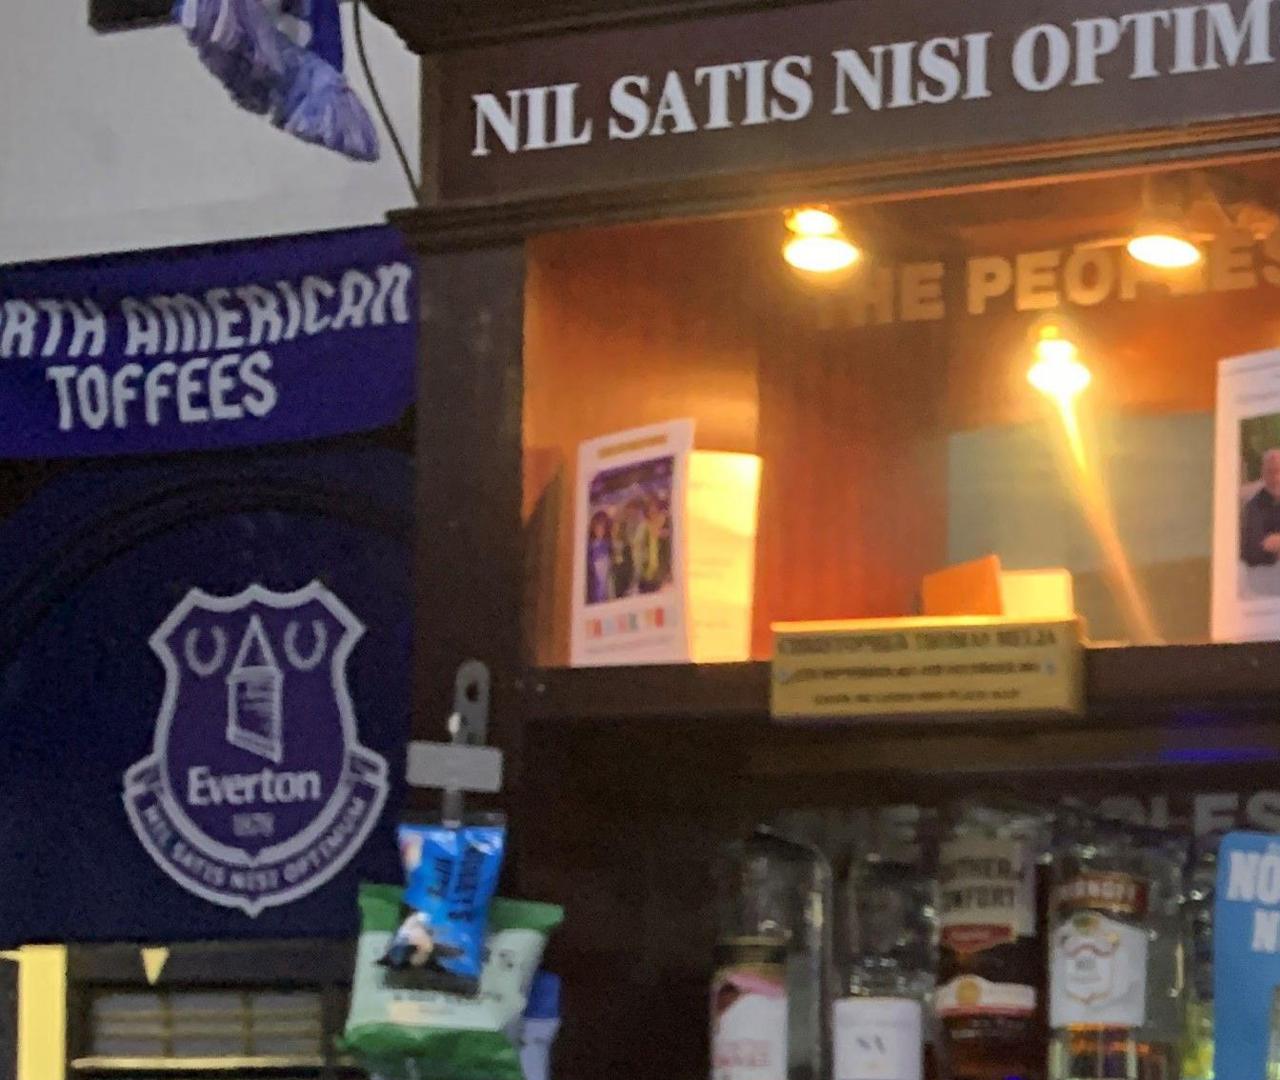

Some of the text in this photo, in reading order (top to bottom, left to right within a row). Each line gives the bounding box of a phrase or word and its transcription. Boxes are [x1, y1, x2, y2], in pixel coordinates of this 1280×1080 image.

[472, 82, 592, 156] NIL
[608, 55, 813, 140] SATIS
[831, 33, 993, 116] NISI
[122, 262, 412, 356] AMERICAN
[46, 350, 278, 431] TOFFEES
[187, 765, 322, 806] Everton
